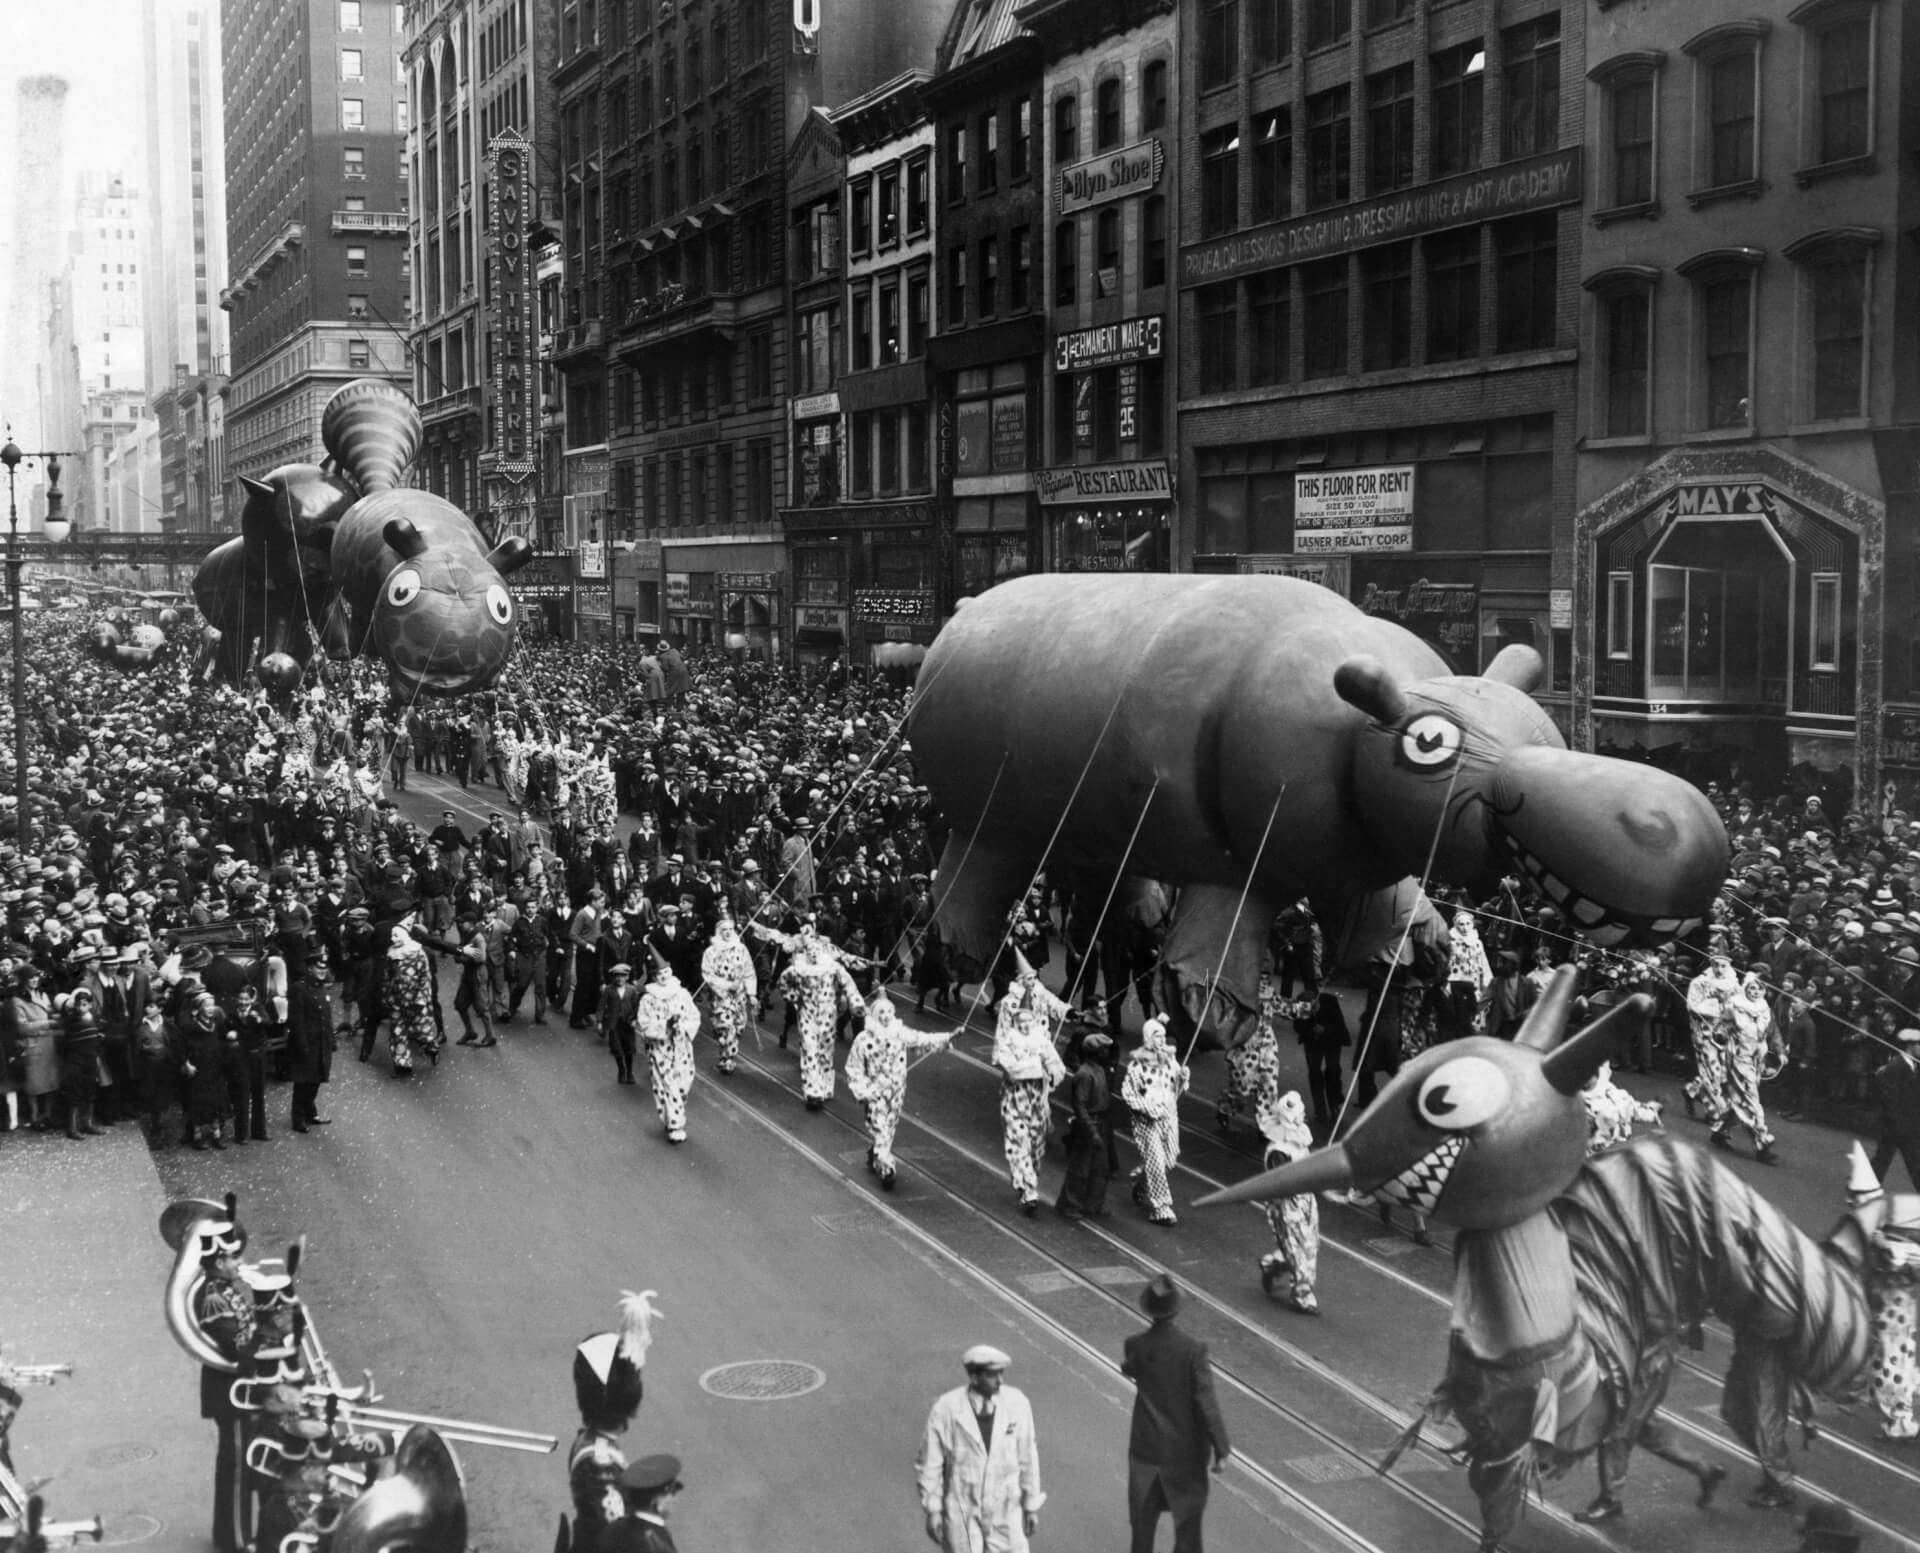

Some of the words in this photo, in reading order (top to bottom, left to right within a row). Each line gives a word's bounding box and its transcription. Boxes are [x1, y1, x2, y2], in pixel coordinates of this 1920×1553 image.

[1072, 168, 1106, 201] Blyn
[1110, 155, 1150, 189] Shoe
[1451, 192, 1460, 217] &
[1463, 179, 1493, 214] ART
[1496, 161, 1572, 207] ACADEMY
[502, 158, 521, 273] SAVOY
[1069, 325, 1118, 359] PERMANENT
[1121, 320, 1144, 349] WAVE
[503, 289, 523, 455] THEATRE
[1119, 406, 1135, 437] 25
[1072, 467, 1168, 496] RESTAURANT
[1297, 478, 1320, 499] THIS
[1322, 475, 1355, 497] FLOOR
[1356, 474, 1377, 494] FOR
[1379, 471, 1412, 493] RENT
[1677, 485, 1764, 515] MAY'S
[1297, 536, 1332, 548] LASNER
[1335, 535, 1374, 547] REALTY
[1376, 534, 1410, 545] CORP.
[863, 597, 892, 614] CHOP
[893, 598, 923, 614] SUEY
[1648, 704, 1668, 714] 134
